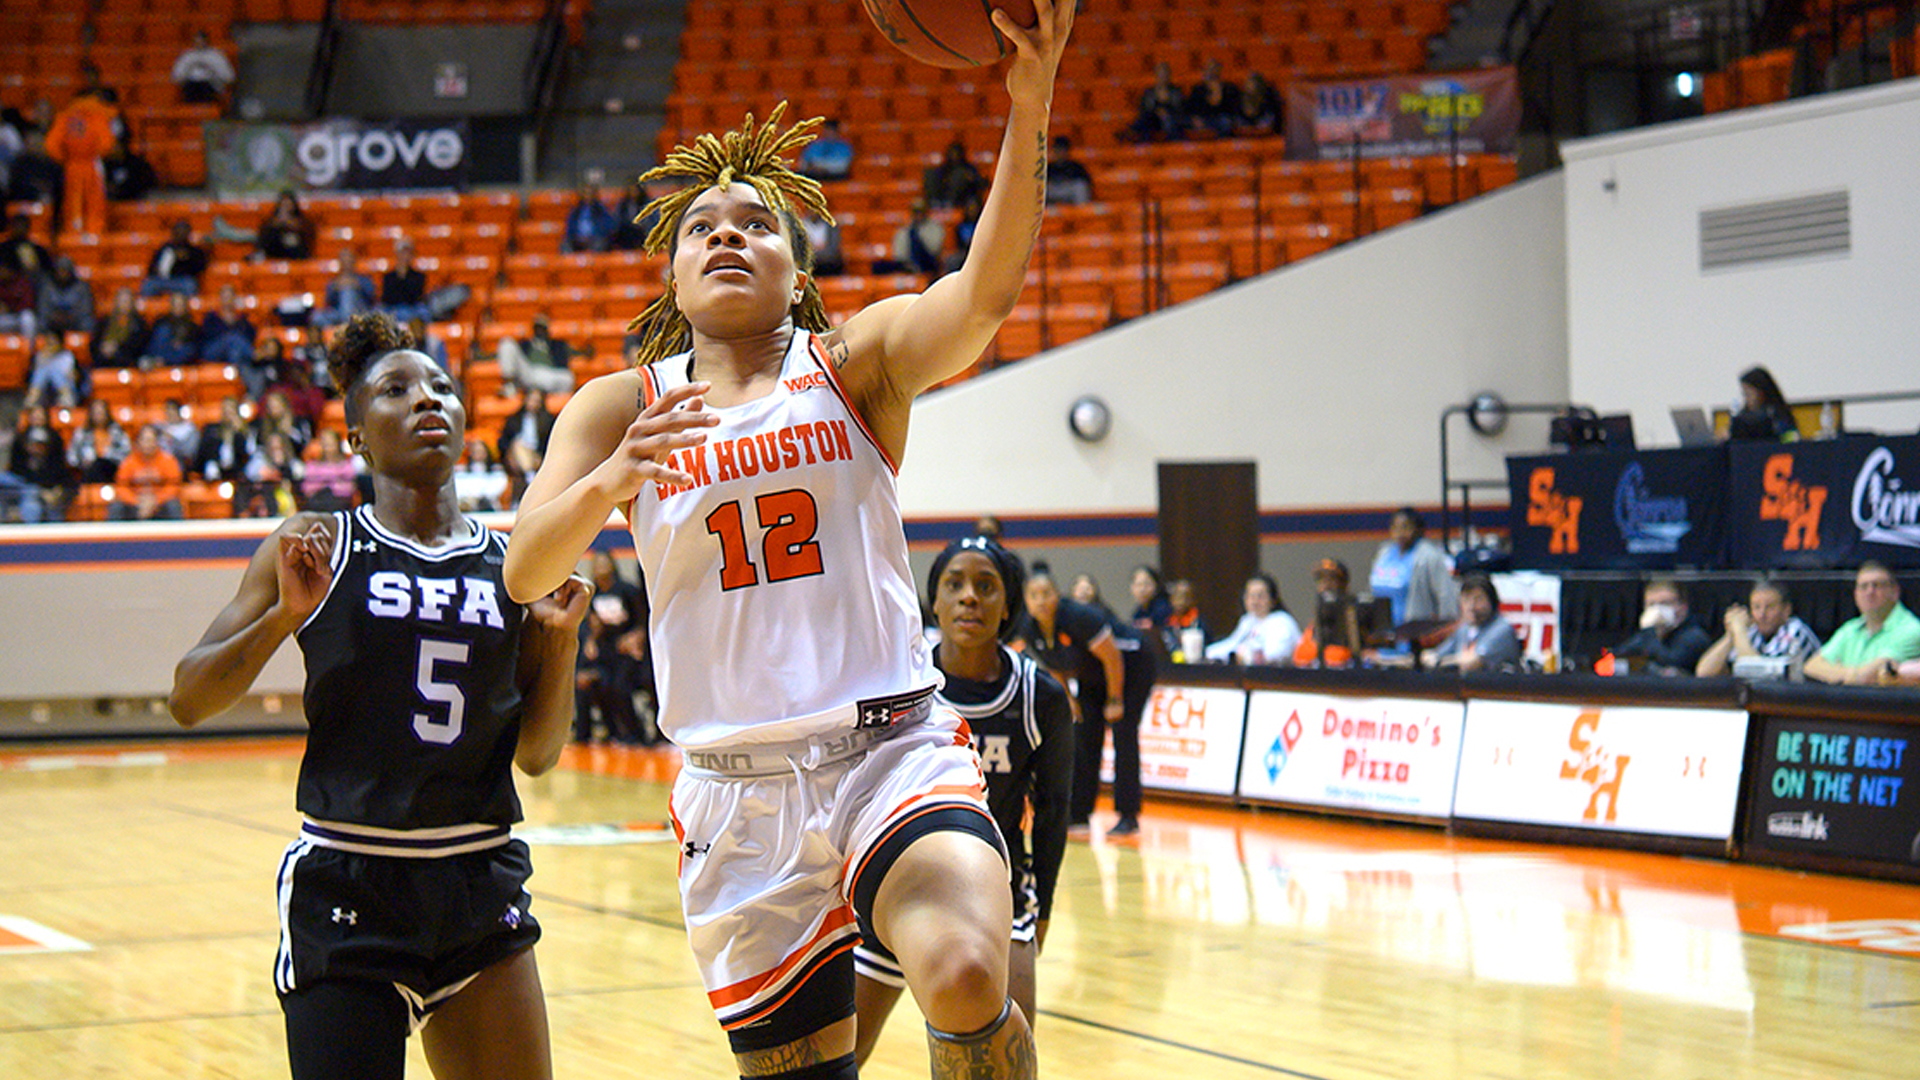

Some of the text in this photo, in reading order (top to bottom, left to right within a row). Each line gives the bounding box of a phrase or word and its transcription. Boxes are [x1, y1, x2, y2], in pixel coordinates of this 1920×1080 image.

[298, 128, 463, 186] grove
[783, 371, 827, 392] WAC
[713, 419, 853, 482] HOUSTON
[705, 488, 825, 592] 12
[368, 571, 505, 630] SFA
[410, 635, 474, 747] 5
[1323, 709, 1441, 746] Domino's
[1776, 731, 1907, 770] BE THE BEST
[1342, 749, 1410, 784] Pizza
[1771, 767, 1904, 808] ON THE NET
